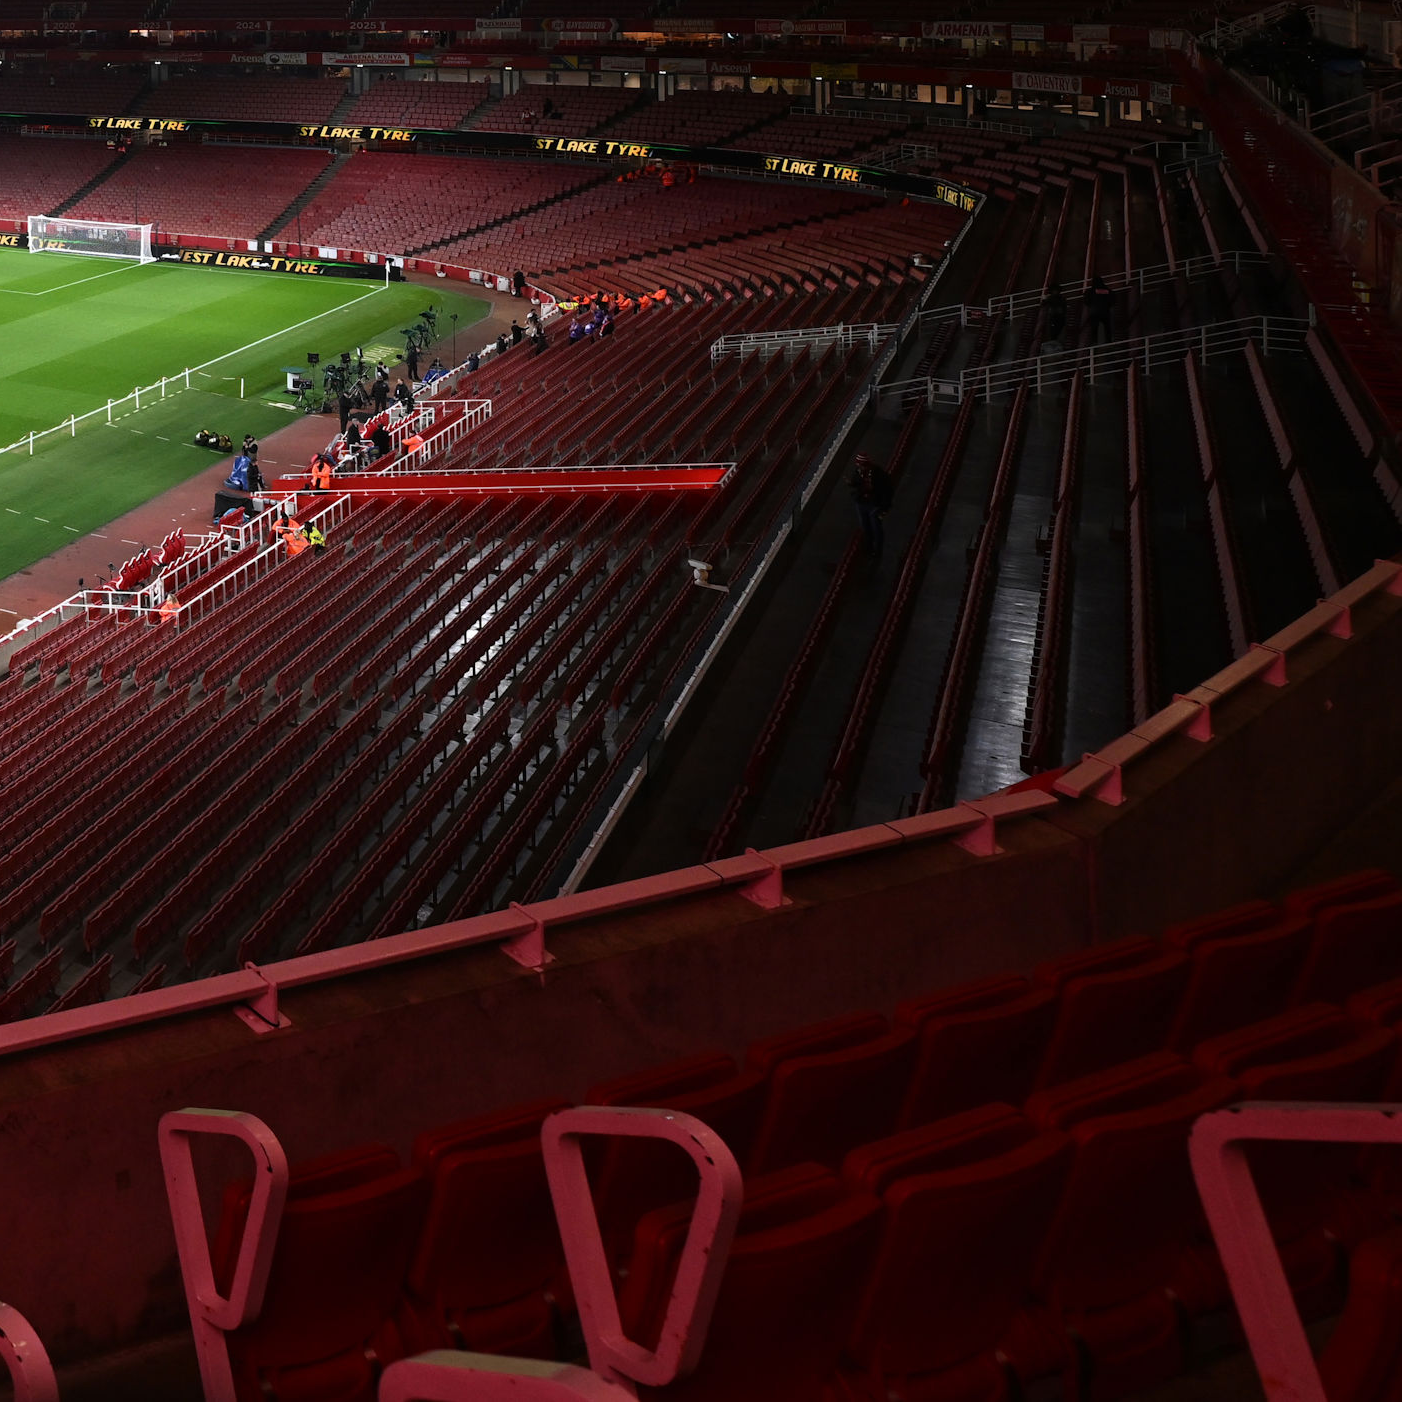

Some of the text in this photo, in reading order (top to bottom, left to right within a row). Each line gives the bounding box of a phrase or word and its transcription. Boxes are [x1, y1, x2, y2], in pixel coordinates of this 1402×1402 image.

[53, 22, 75, 30] 2020
[138, 22, 160, 30] 2023
[236, 21, 261, 30] 2024
[349, 21, 377, 30] 2025
[936, 24, 991, 36] ARMENIA
[230, 54, 265, 63] Arsenal
[710, 62, 751, 74] Arsenal
[1026, 75, 1070, 91] DAVENTRY
[1105, 81, 1139, 97] Arsenal
[106, 118, 144, 129] LAKE
[148, 119, 186, 131] TYRE
[319, 125, 362, 139] LAKE
[370, 128, 413, 142] TYRE
[556, 138, 597, 154] LAKE
[605, 142, 648, 157] TYRE
[781, 159, 817, 176] LAKE
[822, 163, 859, 182] TYRE
[178, 250, 213, 264] EST
[270, 257, 319, 274] TYRE
